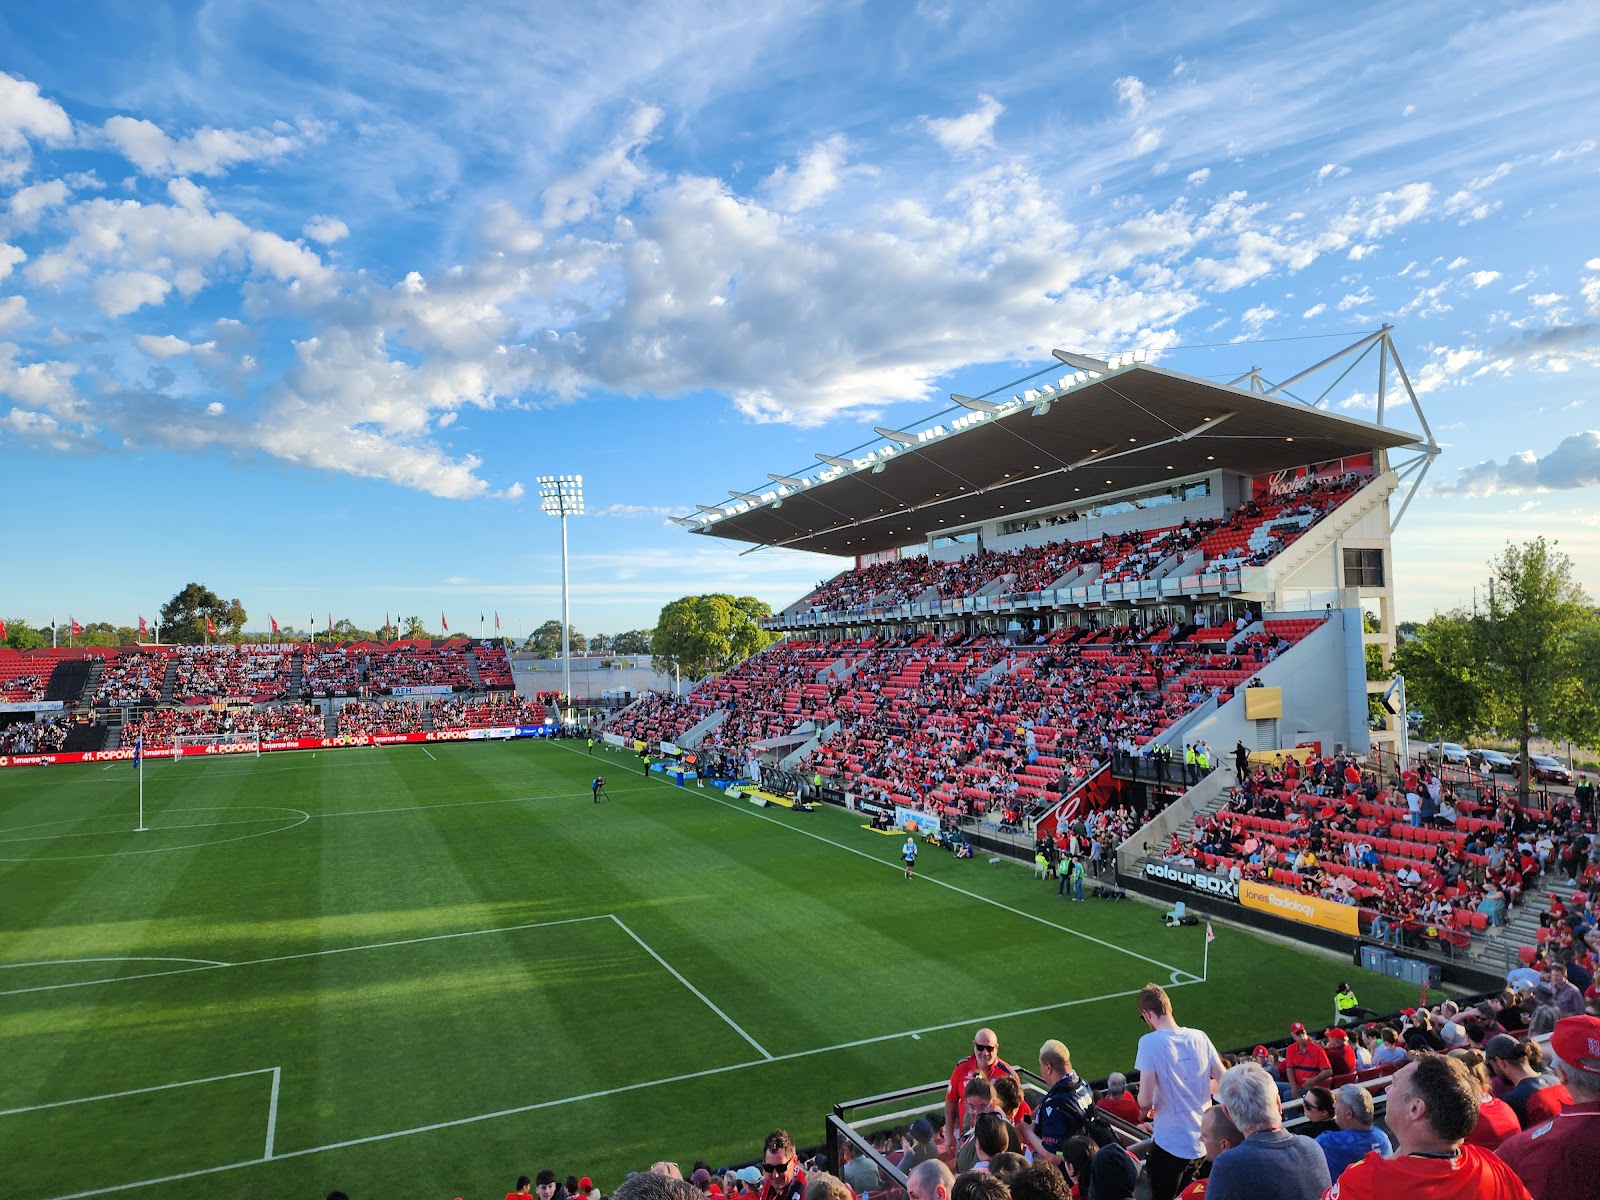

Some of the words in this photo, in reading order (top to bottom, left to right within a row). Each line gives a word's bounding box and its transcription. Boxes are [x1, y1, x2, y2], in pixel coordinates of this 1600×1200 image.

[176, 644, 236, 654] COOPERS
[240, 643, 294, 653] STADIUM
[211, 695, 252, 704] Vidmar
[1246, 889, 1270, 903] Jones
[1268, 893, 1315, 918] Radiology
